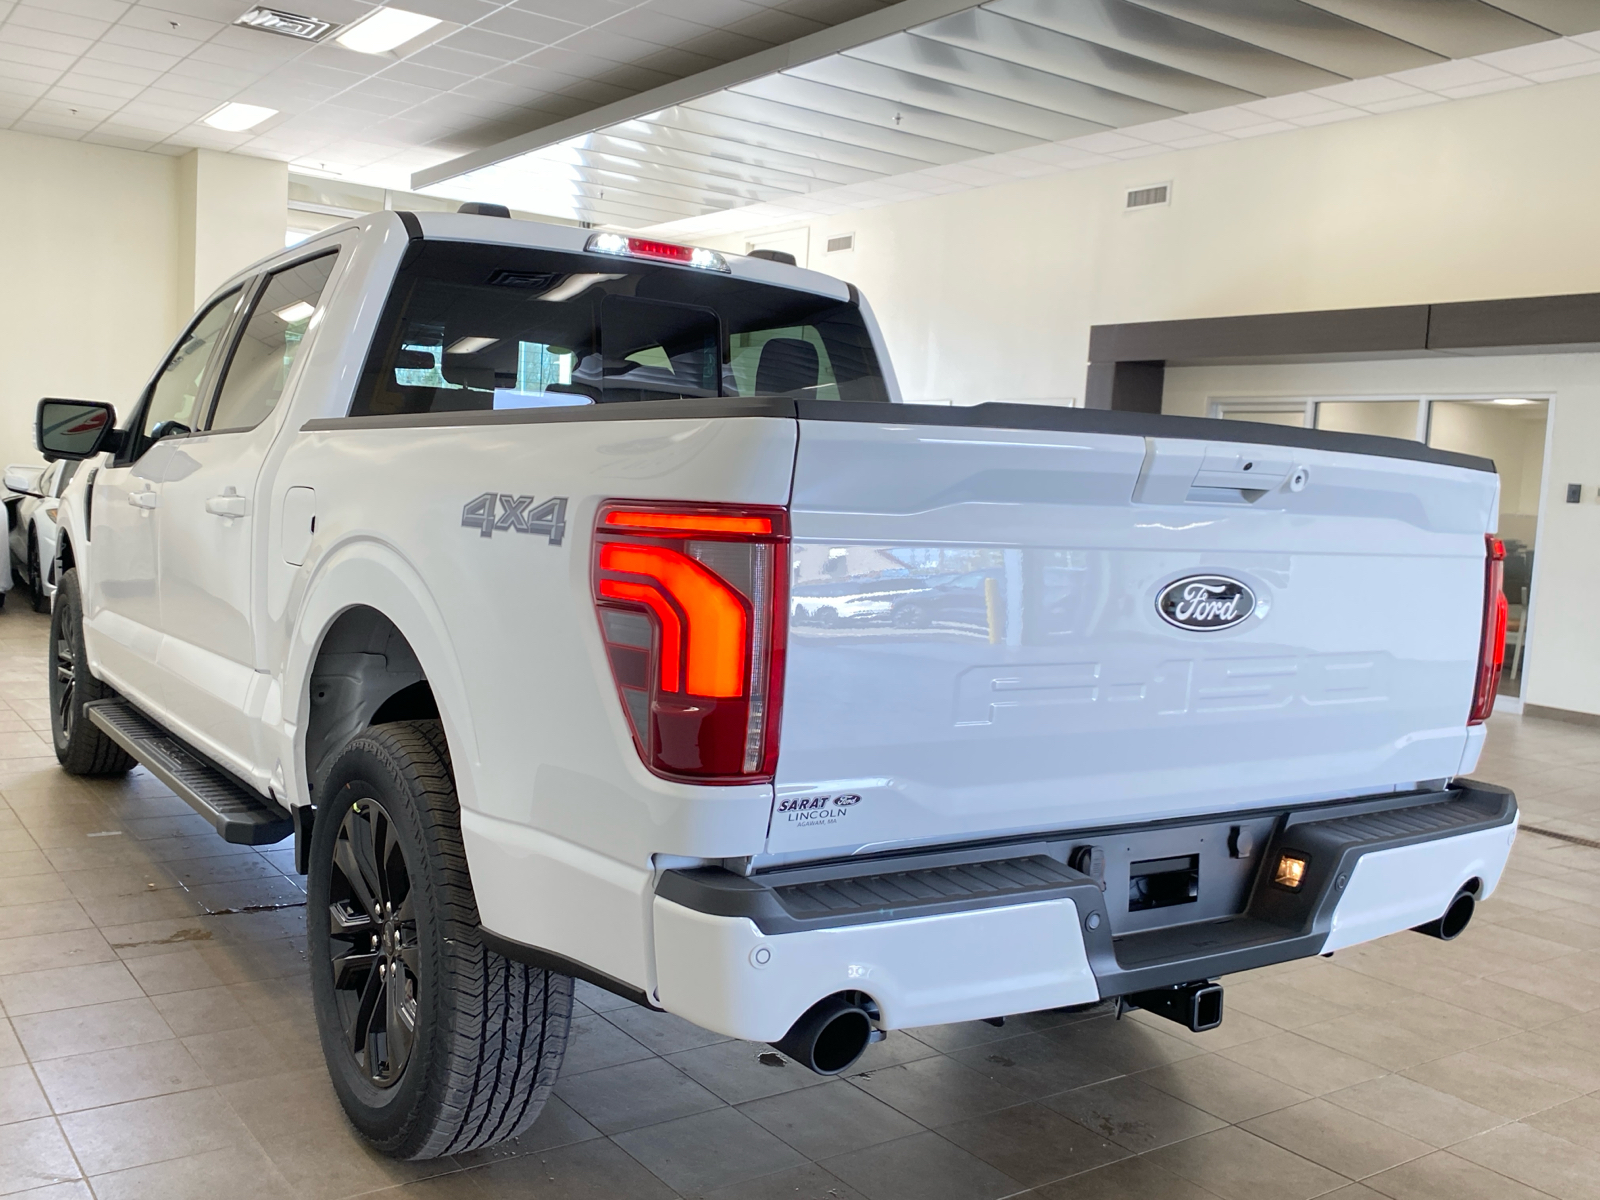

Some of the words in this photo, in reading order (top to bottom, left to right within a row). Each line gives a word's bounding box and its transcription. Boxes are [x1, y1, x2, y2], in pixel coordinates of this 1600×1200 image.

[1175, 583, 1240, 620] Ford
[954, 650, 1396, 727] F-150
[778, 796, 830, 812] SARAT
[787, 808, 847, 822] LINCOLN
